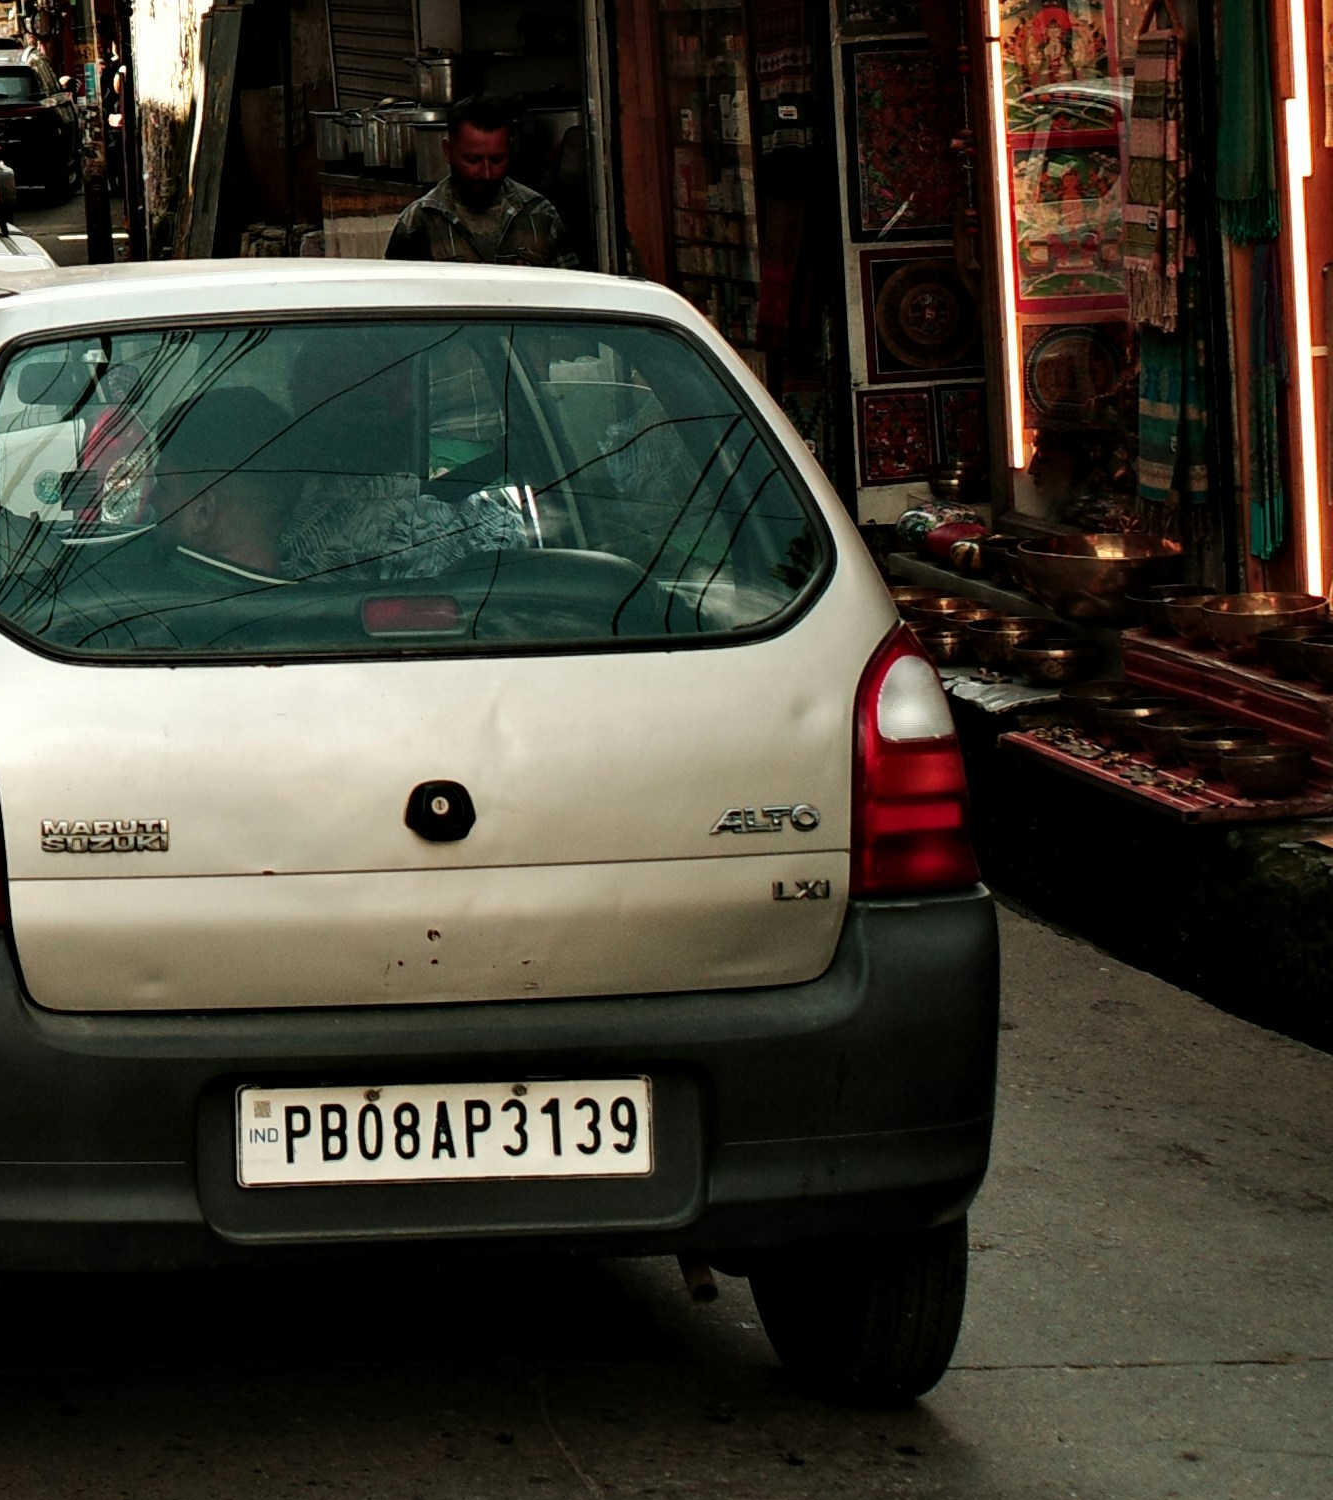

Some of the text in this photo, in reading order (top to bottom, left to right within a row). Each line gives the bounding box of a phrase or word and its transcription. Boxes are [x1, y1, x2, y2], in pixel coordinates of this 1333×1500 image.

[42, 819, 168, 835] MARUTI
[709, 804, 820, 835] ALTO
[41, 835, 169, 852] SUZUKI
[249, 1096, 638, 1163] IND PB08AP3139
